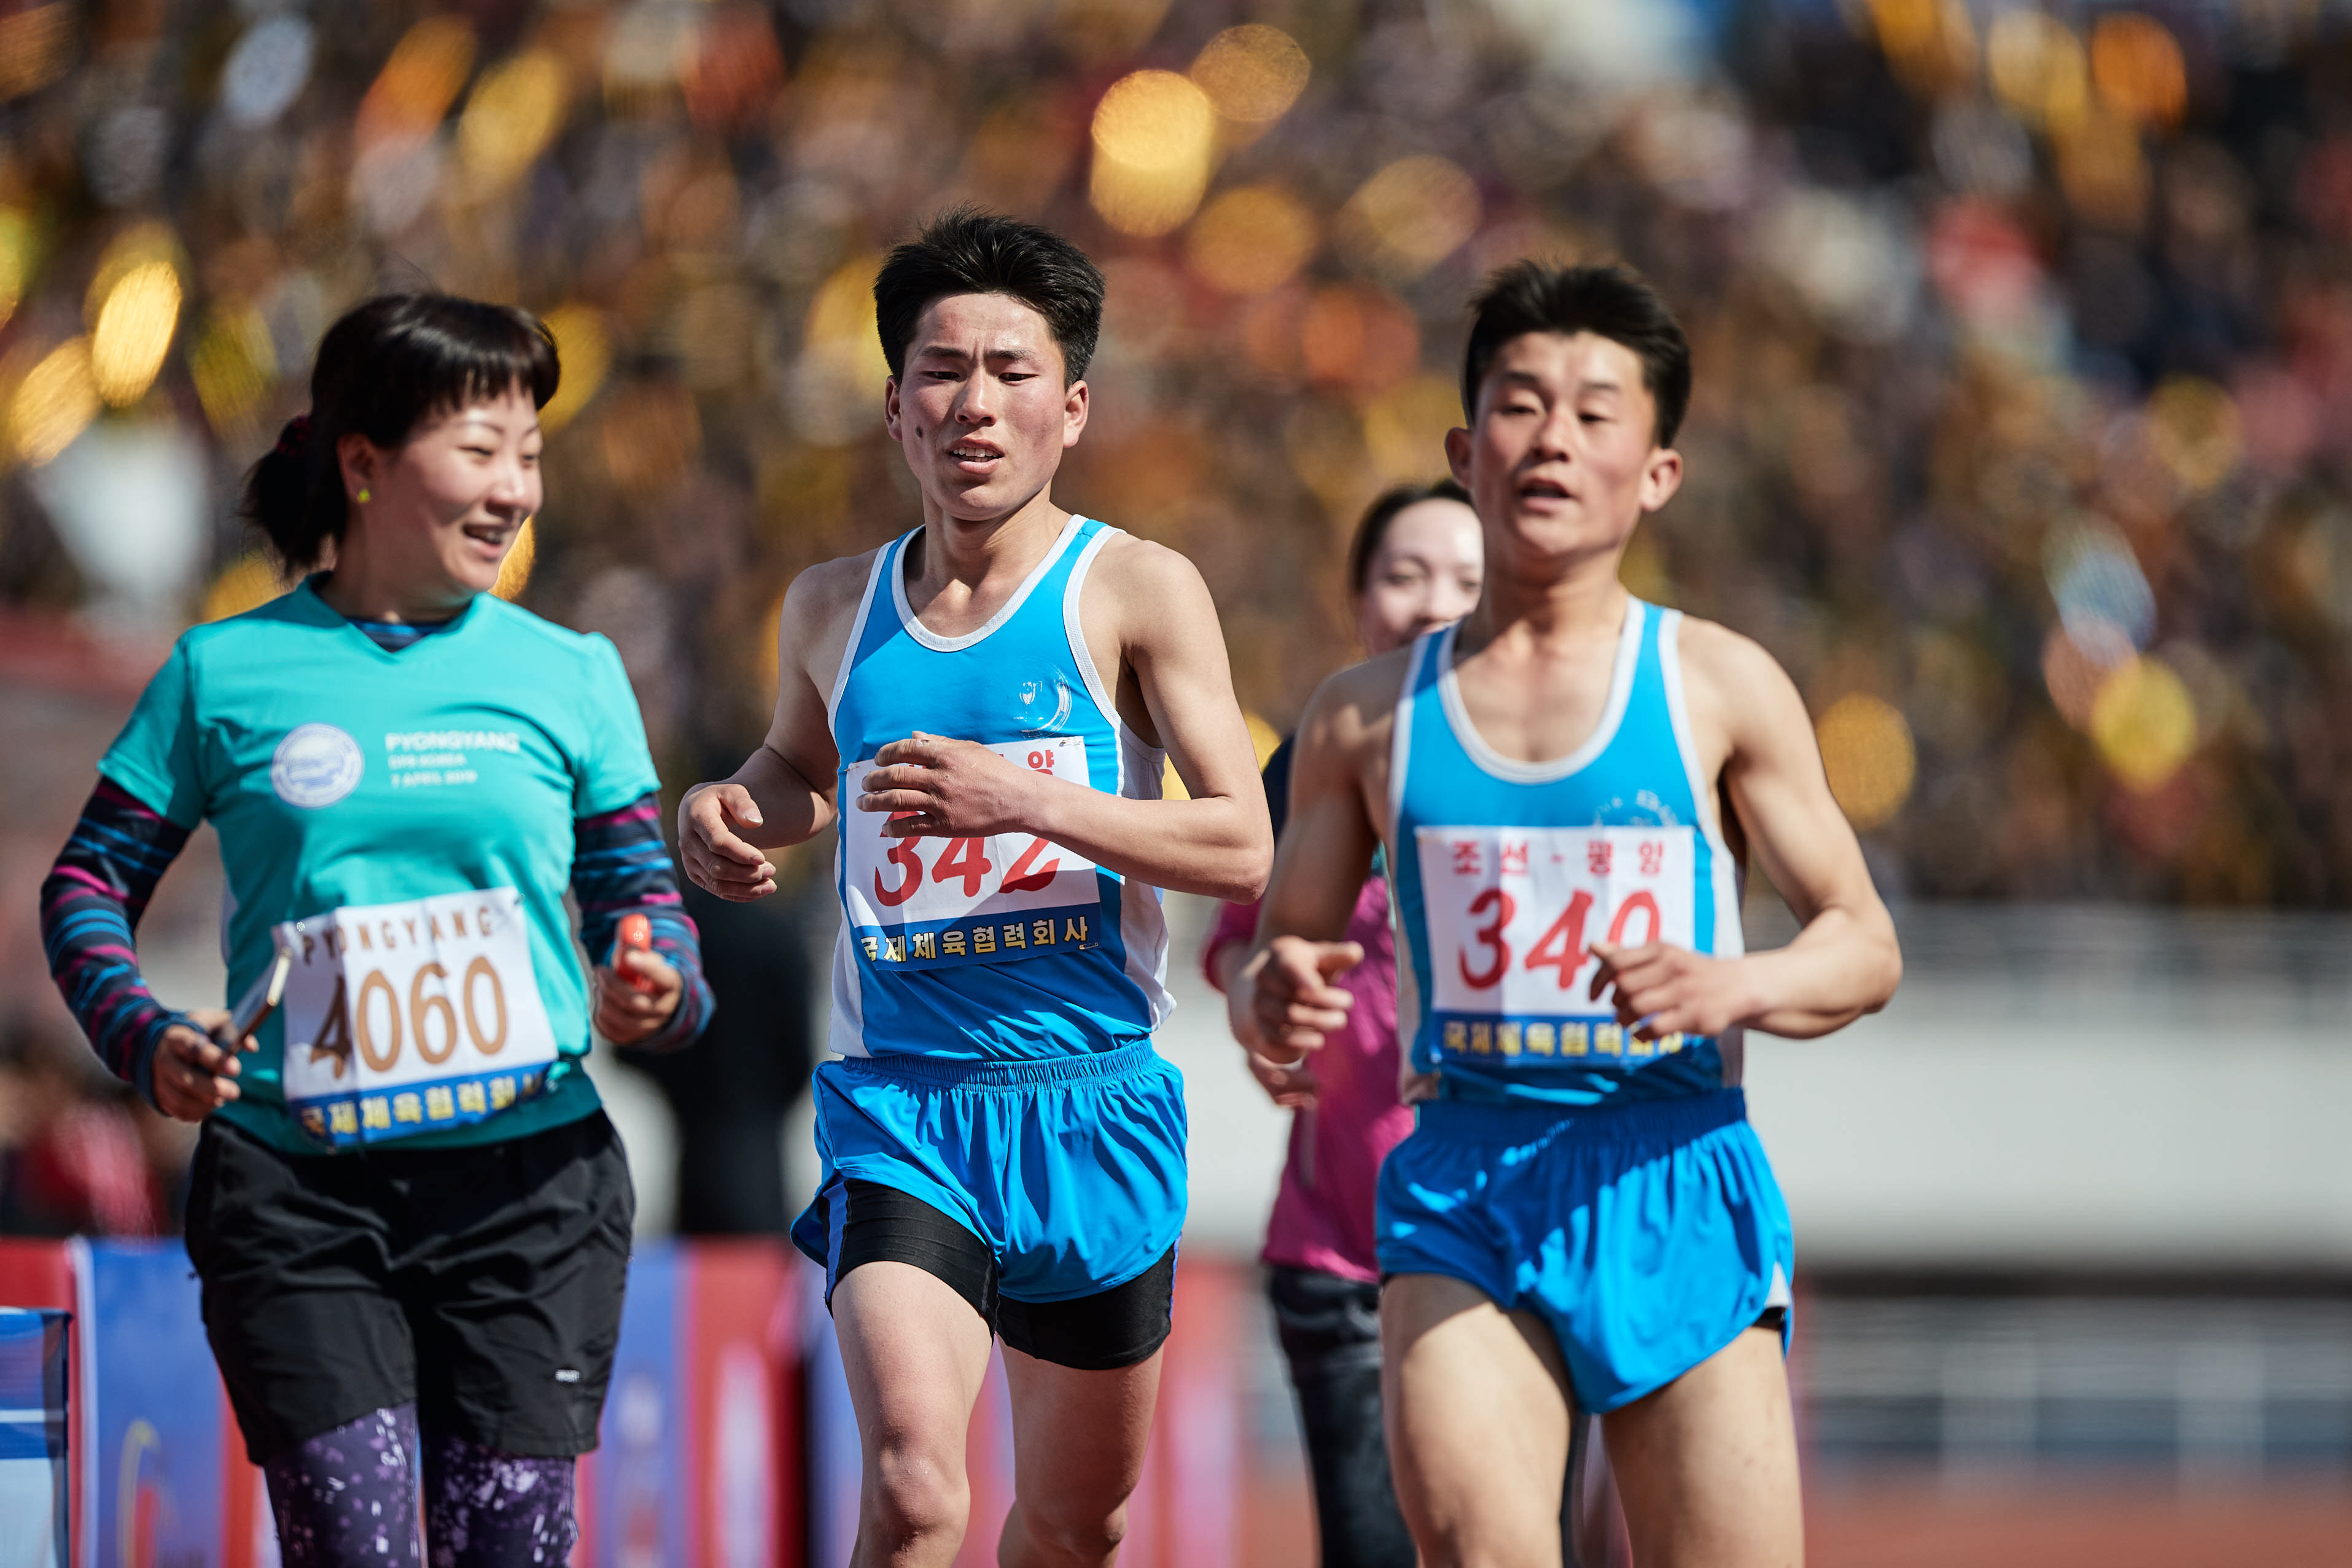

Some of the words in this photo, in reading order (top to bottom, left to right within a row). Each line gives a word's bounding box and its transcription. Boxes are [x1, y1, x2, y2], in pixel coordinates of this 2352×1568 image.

[385, 730, 520, 753] PYONGYANG
[874, 811, 1061, 907] 342
[1457, 887, 1661, 991] 340
[310, 955, 507, 1079] 4060
